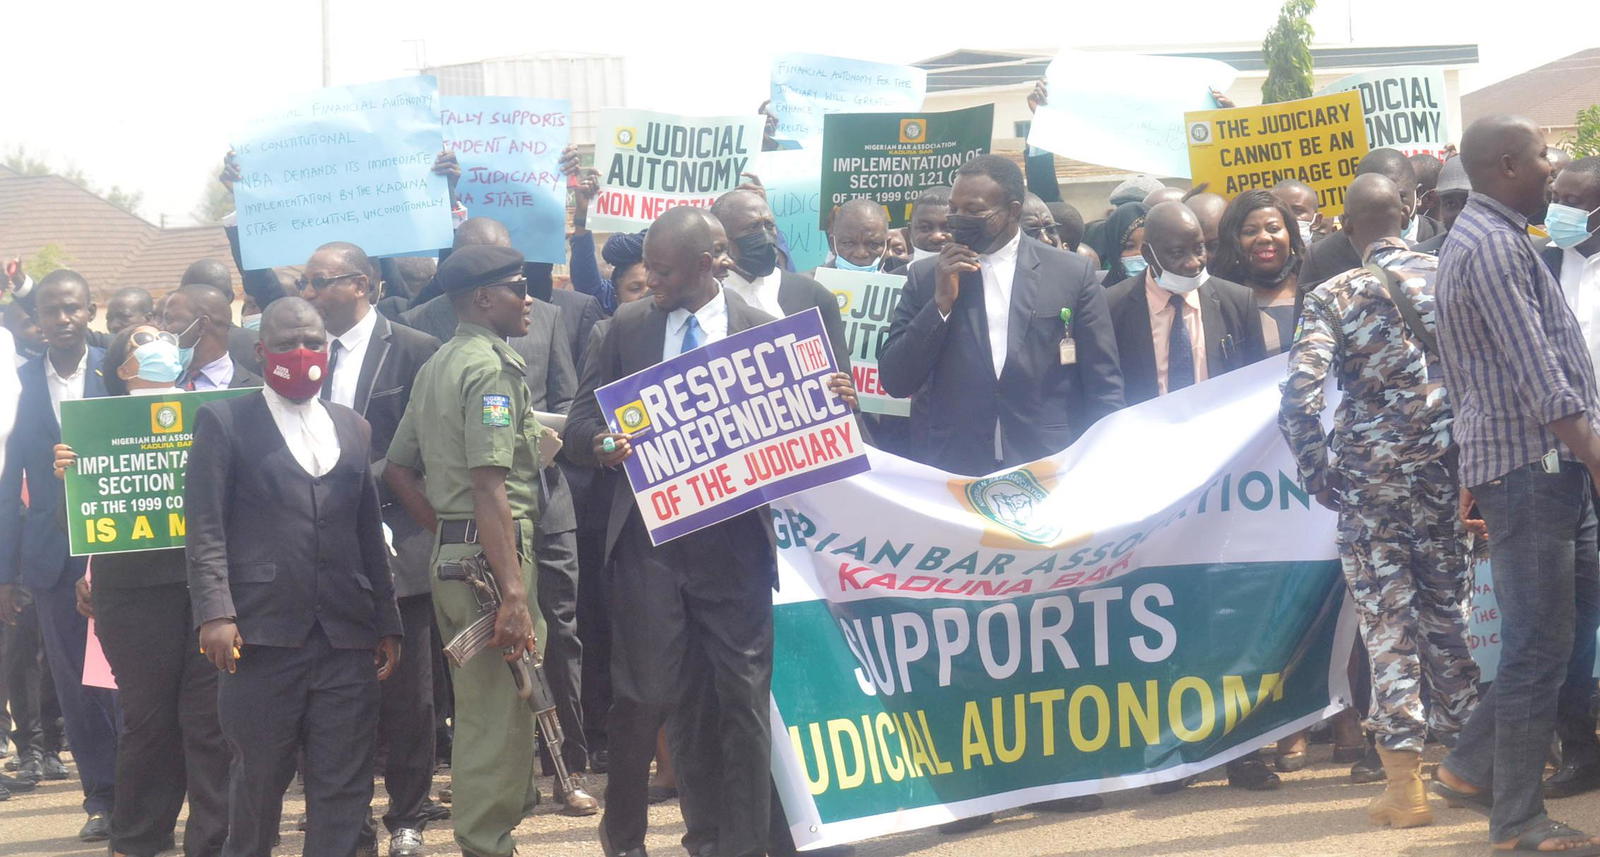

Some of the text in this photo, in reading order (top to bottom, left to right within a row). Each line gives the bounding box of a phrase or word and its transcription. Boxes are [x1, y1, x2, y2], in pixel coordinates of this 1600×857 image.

[312, 98, 380, 117] FINANCIAL
[382, 93, 433, 111] AUTONOMY
[488, 110, 566, 127] SUPPORTS
[1216, 117, 1251, 140] THE
[1257, 103, 1350, 136] JUDICIARY
[261, 131, 360, 151] CONSTITUTIONAL
[508, 139, 547, 155] AND
[636, 121, 748, 159] JUDICIAL
[915, 141, 957, 150] ASSOCIATION
[1220, 130, 1355, 167] CANNOT BE AN
[241, 153, 432, 190] NBA DEMANDS ITS IMMEDIATE
[607, 152, 749, 193] AUTONOMY
[832, 152, 962, 172] IMPLEMENTATION
[1226, 156, 1360, 194] APPENDAGE OF
[467, 166, 560, 191] JUDICIARY
[849, 173, 914, 189] SECTION
[918, 170, 944, 187] 121
[244, 177, 428, 216] IMPLEMENTATION BY THE KADUNA
[482, 191, 535, 208] STATE
[596, 190, 635, 218] NON
[766, 187, 819, 217] UDIC
[832, 193, 847, 204] OF
[876, 191, 901, 202] 1999
[904, 190, 922, 201] CO
[246, 222, 281, 237] STATE
[639, 333, 828, 433] RESPECT THE
[112, 437, 150, 446] NIGERIAN
[151, 435, 168, 443] BAR
[635, 372, 846, 484] INDEPENDENCE
[98, 472, 175, 496] SECTION
[650, 422, 855, 521] OF THE JUDICIARY
[81, 502, 97, 515] OF
[101, 500, 127, 514] THE
[131, 497, 162, 512] 1999
[86, 517, 117, 543] IS
[131, 515, 155, 540] A
[915, 546, 1016, 576] BAR
[838, 562, 1034, 597] KADUNA
[839, 582, 1177, 697] SUPPORTS
